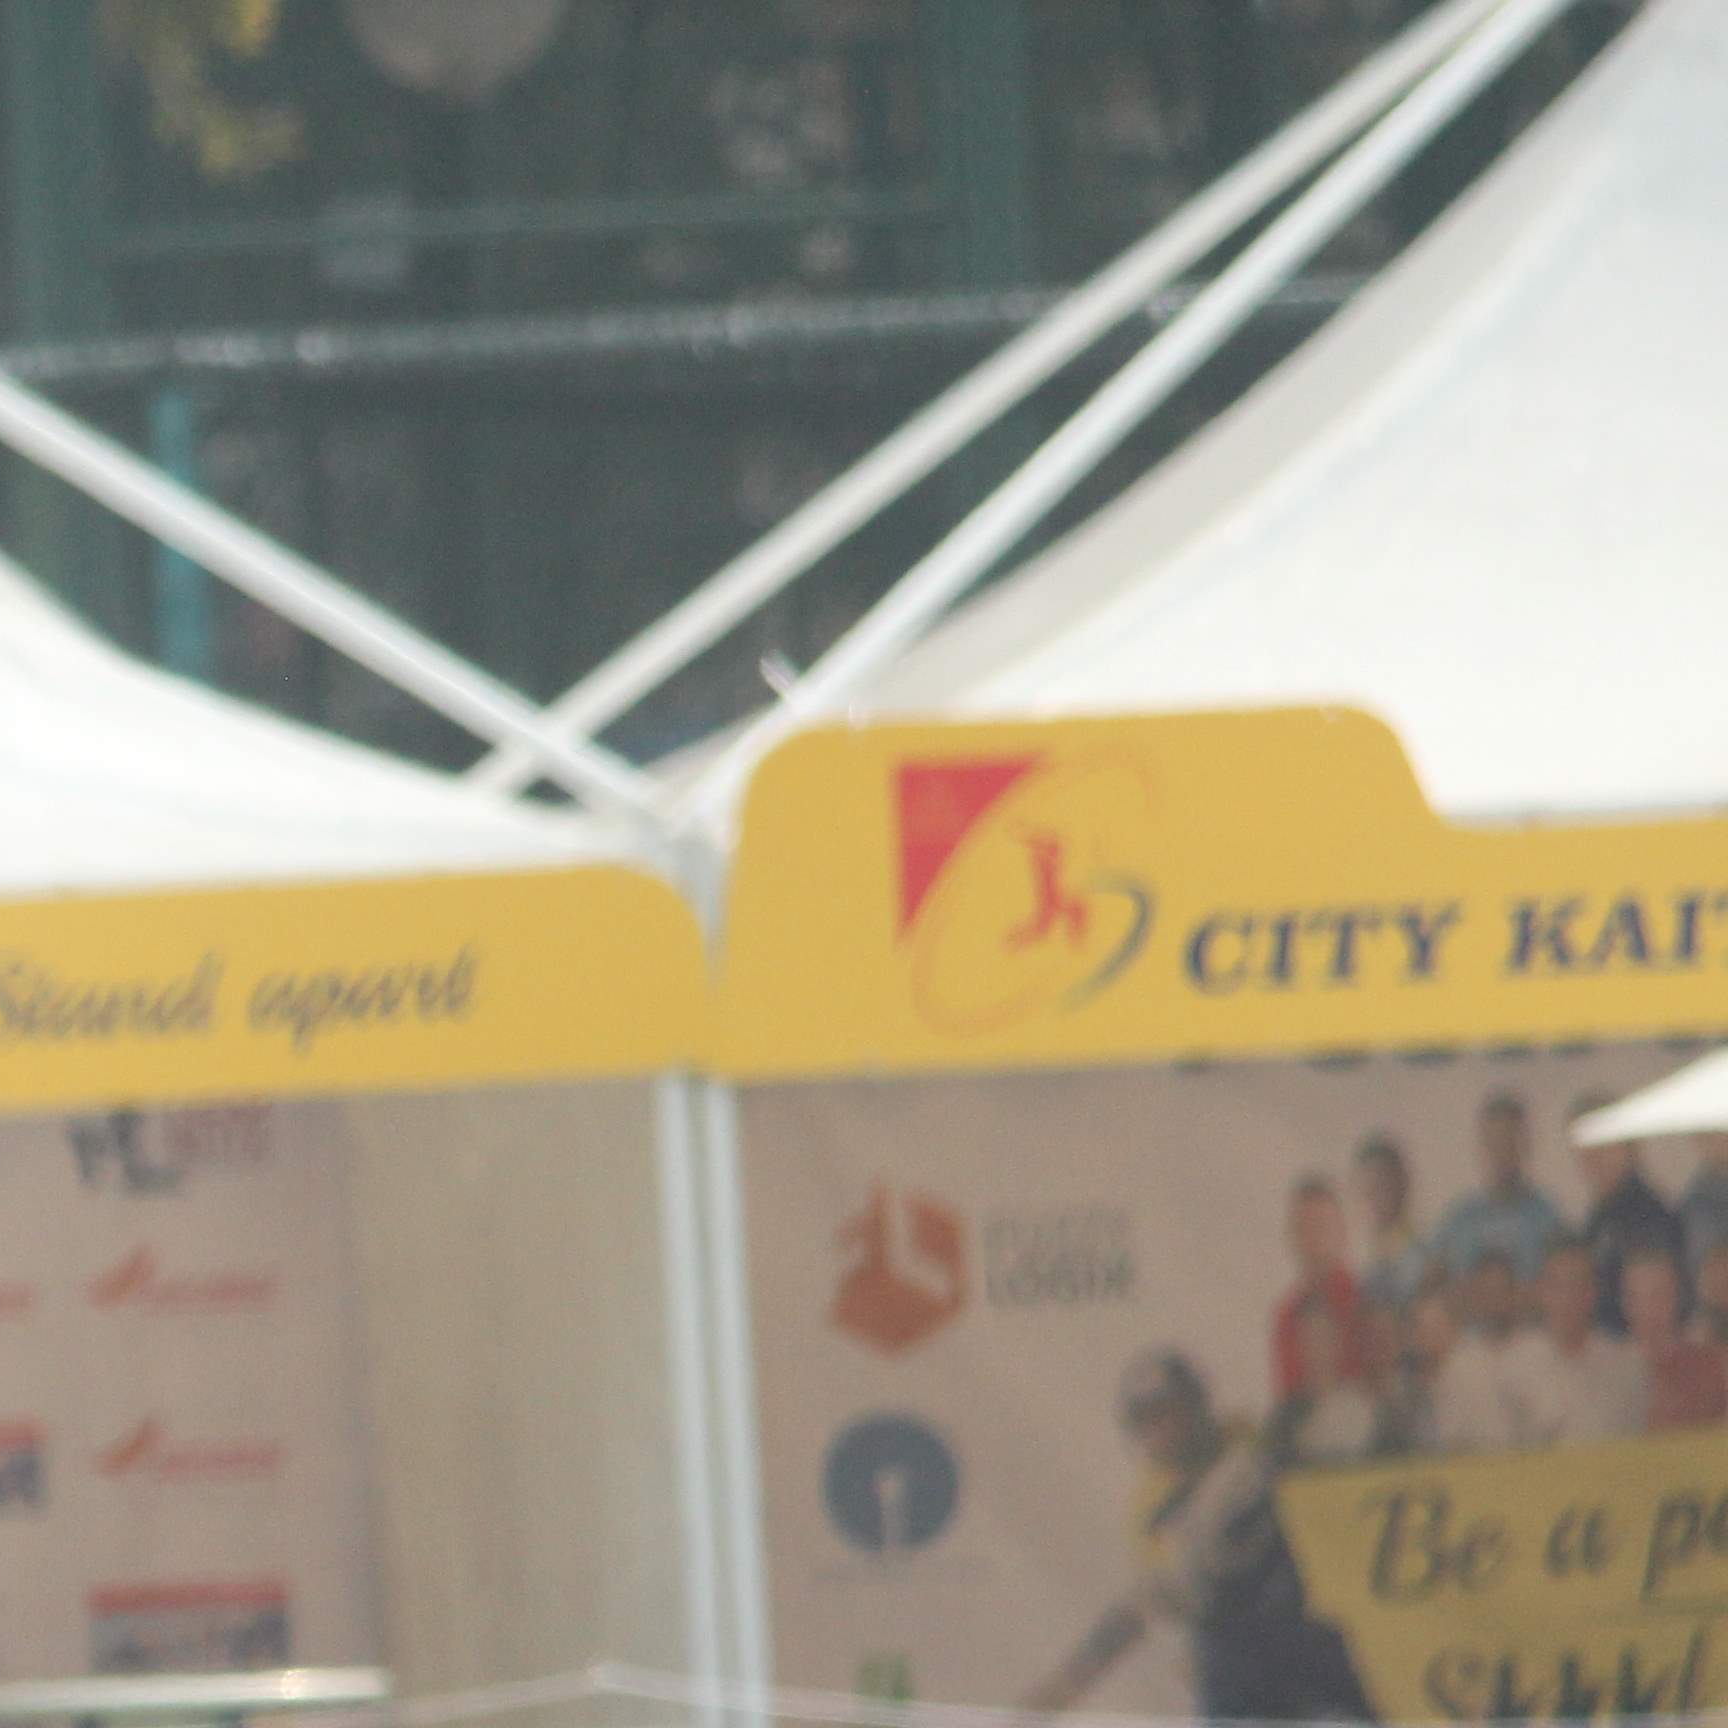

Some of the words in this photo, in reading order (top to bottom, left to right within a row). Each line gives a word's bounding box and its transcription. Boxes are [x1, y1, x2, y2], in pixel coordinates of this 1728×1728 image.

[245, 943, 481, 1058] apart
[1185, 903, 1459, 993] CITY
[1359, 1490, 1509, 1602] Be
